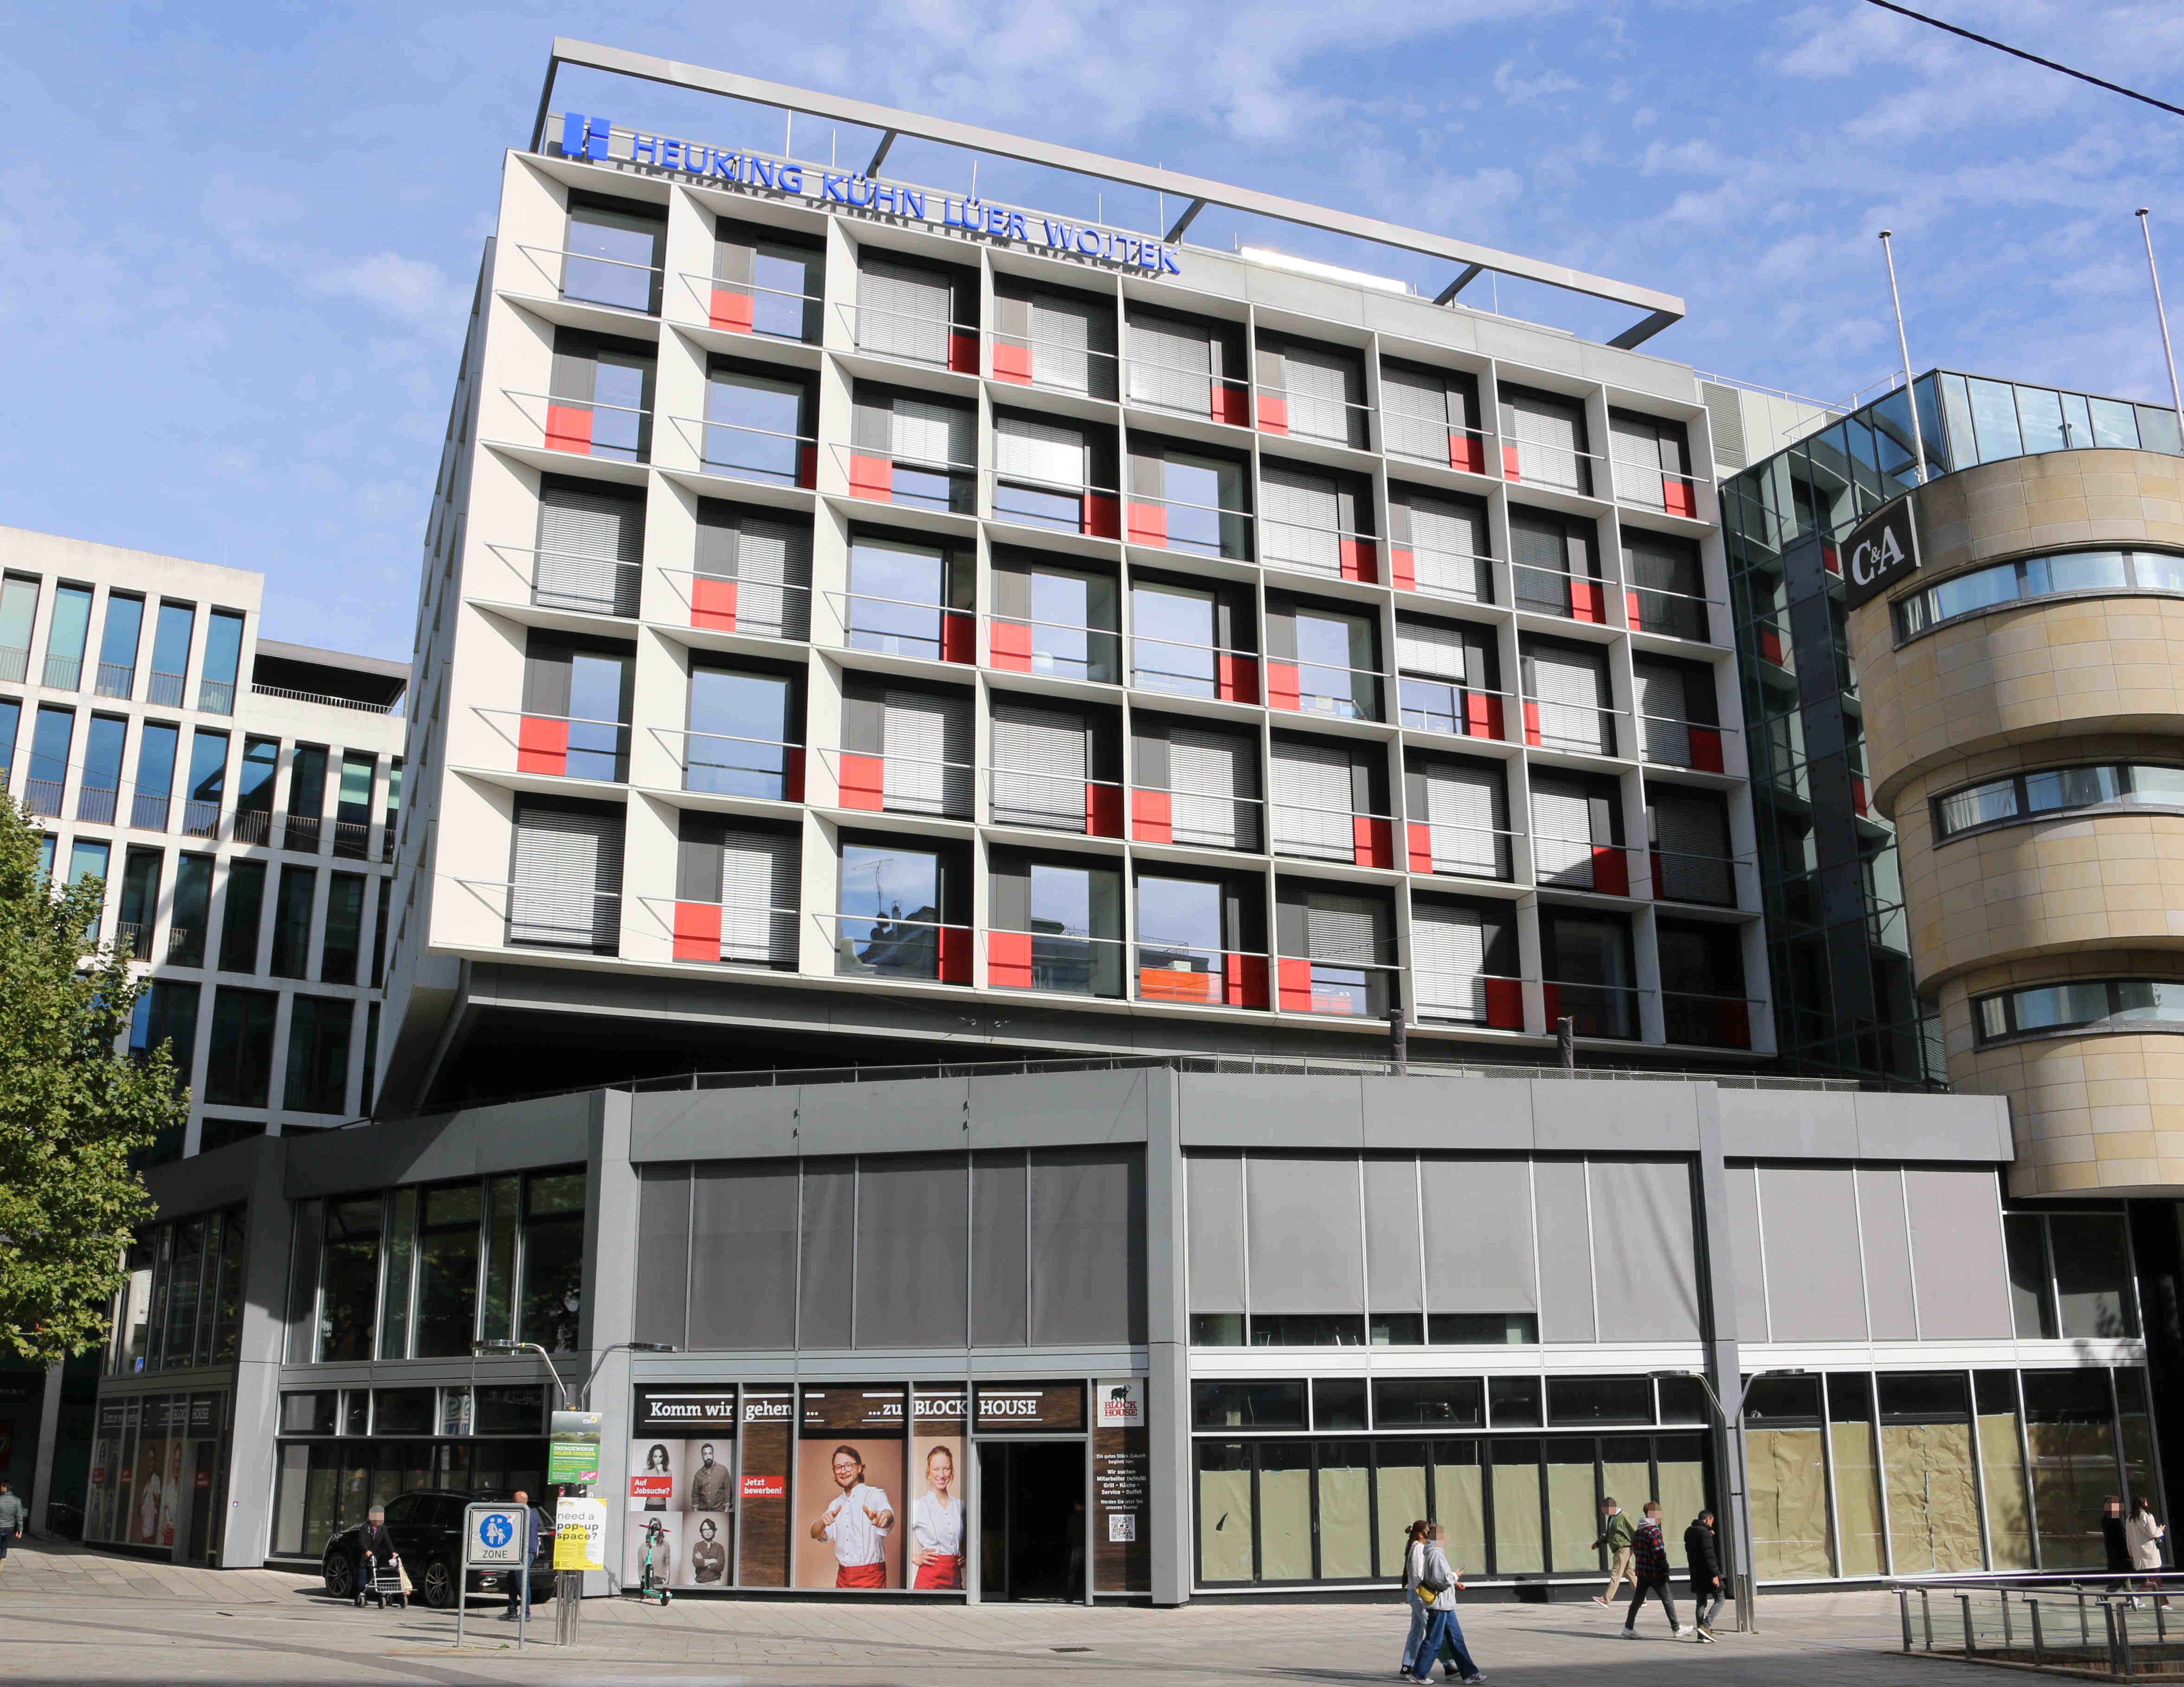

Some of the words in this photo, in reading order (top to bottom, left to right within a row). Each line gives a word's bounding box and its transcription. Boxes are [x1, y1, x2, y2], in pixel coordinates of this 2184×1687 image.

[632, 133, 803, 193] HEUKING
[822, 171, 926, 219] KÜHN
[944, 195, 1029, 240] LÜER
[1044, 218, 1181, 275] WOJTEK
[1852, 525, 1905, 586] C&A
[650, 1402, 702, 1416] Komm
[705, 1401, 733, 1416] wir
[745, 1400, 792, 1420] gehen
[914, 1400, 968, 1415] BLOCK
[979, 1399, 1037, 1415] HOUSE
[558, 1512, 585, 1520] need
[557, 1523, 599, 1532] pop-up
[556, 1532, 597, 1541] space?
[482, 1550, 508, 1558] ZONE
